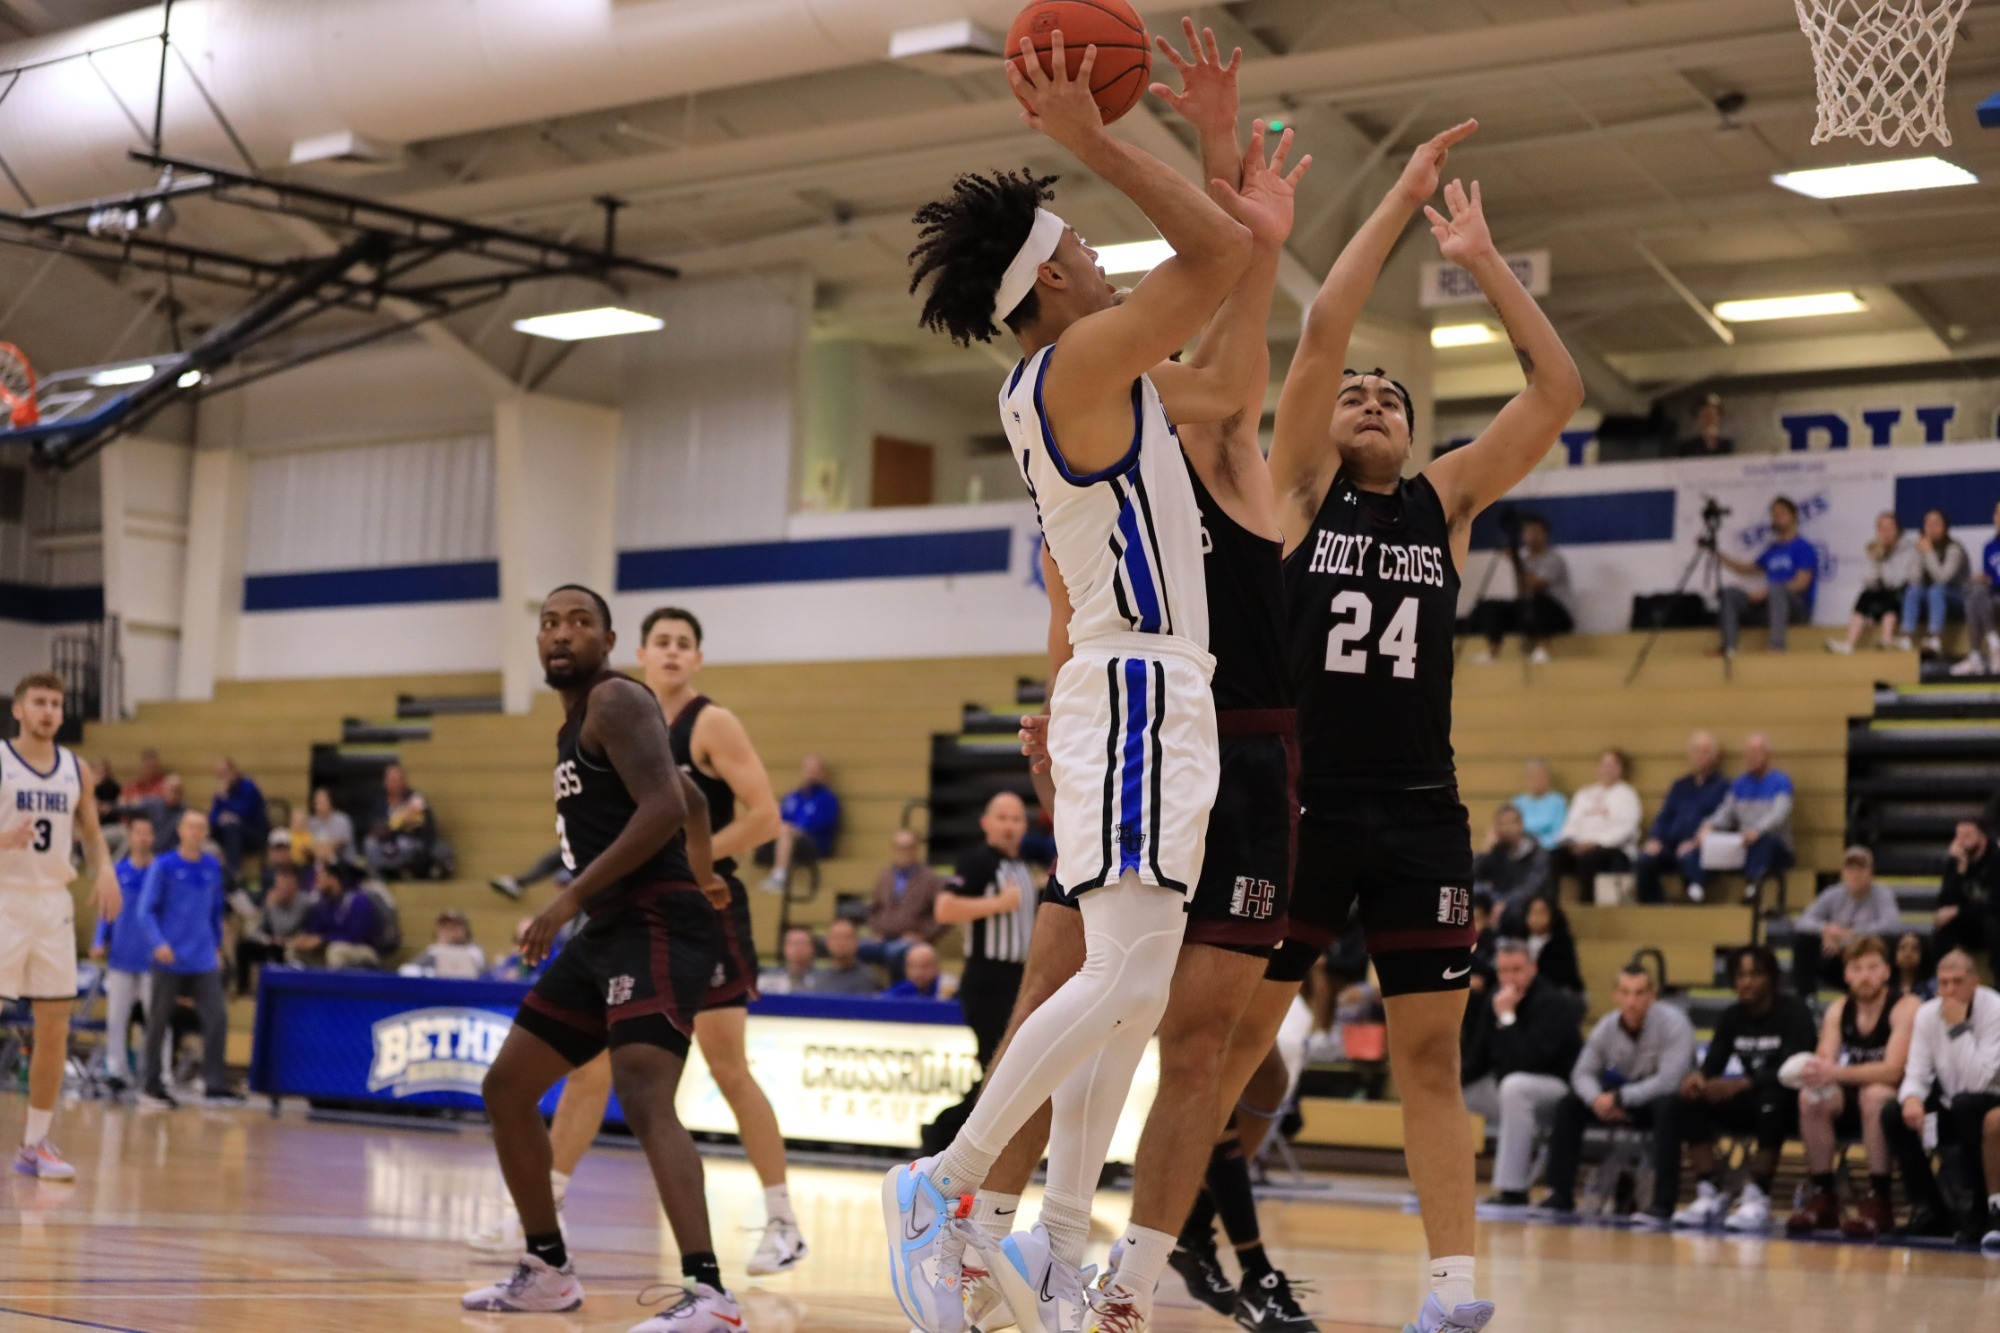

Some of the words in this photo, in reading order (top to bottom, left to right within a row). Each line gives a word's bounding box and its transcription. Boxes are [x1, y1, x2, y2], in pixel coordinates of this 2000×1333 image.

[1309, 529, 1373, 577] HOLY
[1379, 543, 1444, 588] CROSS
[1325, 590, 1419, 679] 24
[16, 790, 69, 813] BETHEL
[33, 818, 52, 853] 3
[375, 1016, 509, 1080] BETHE
